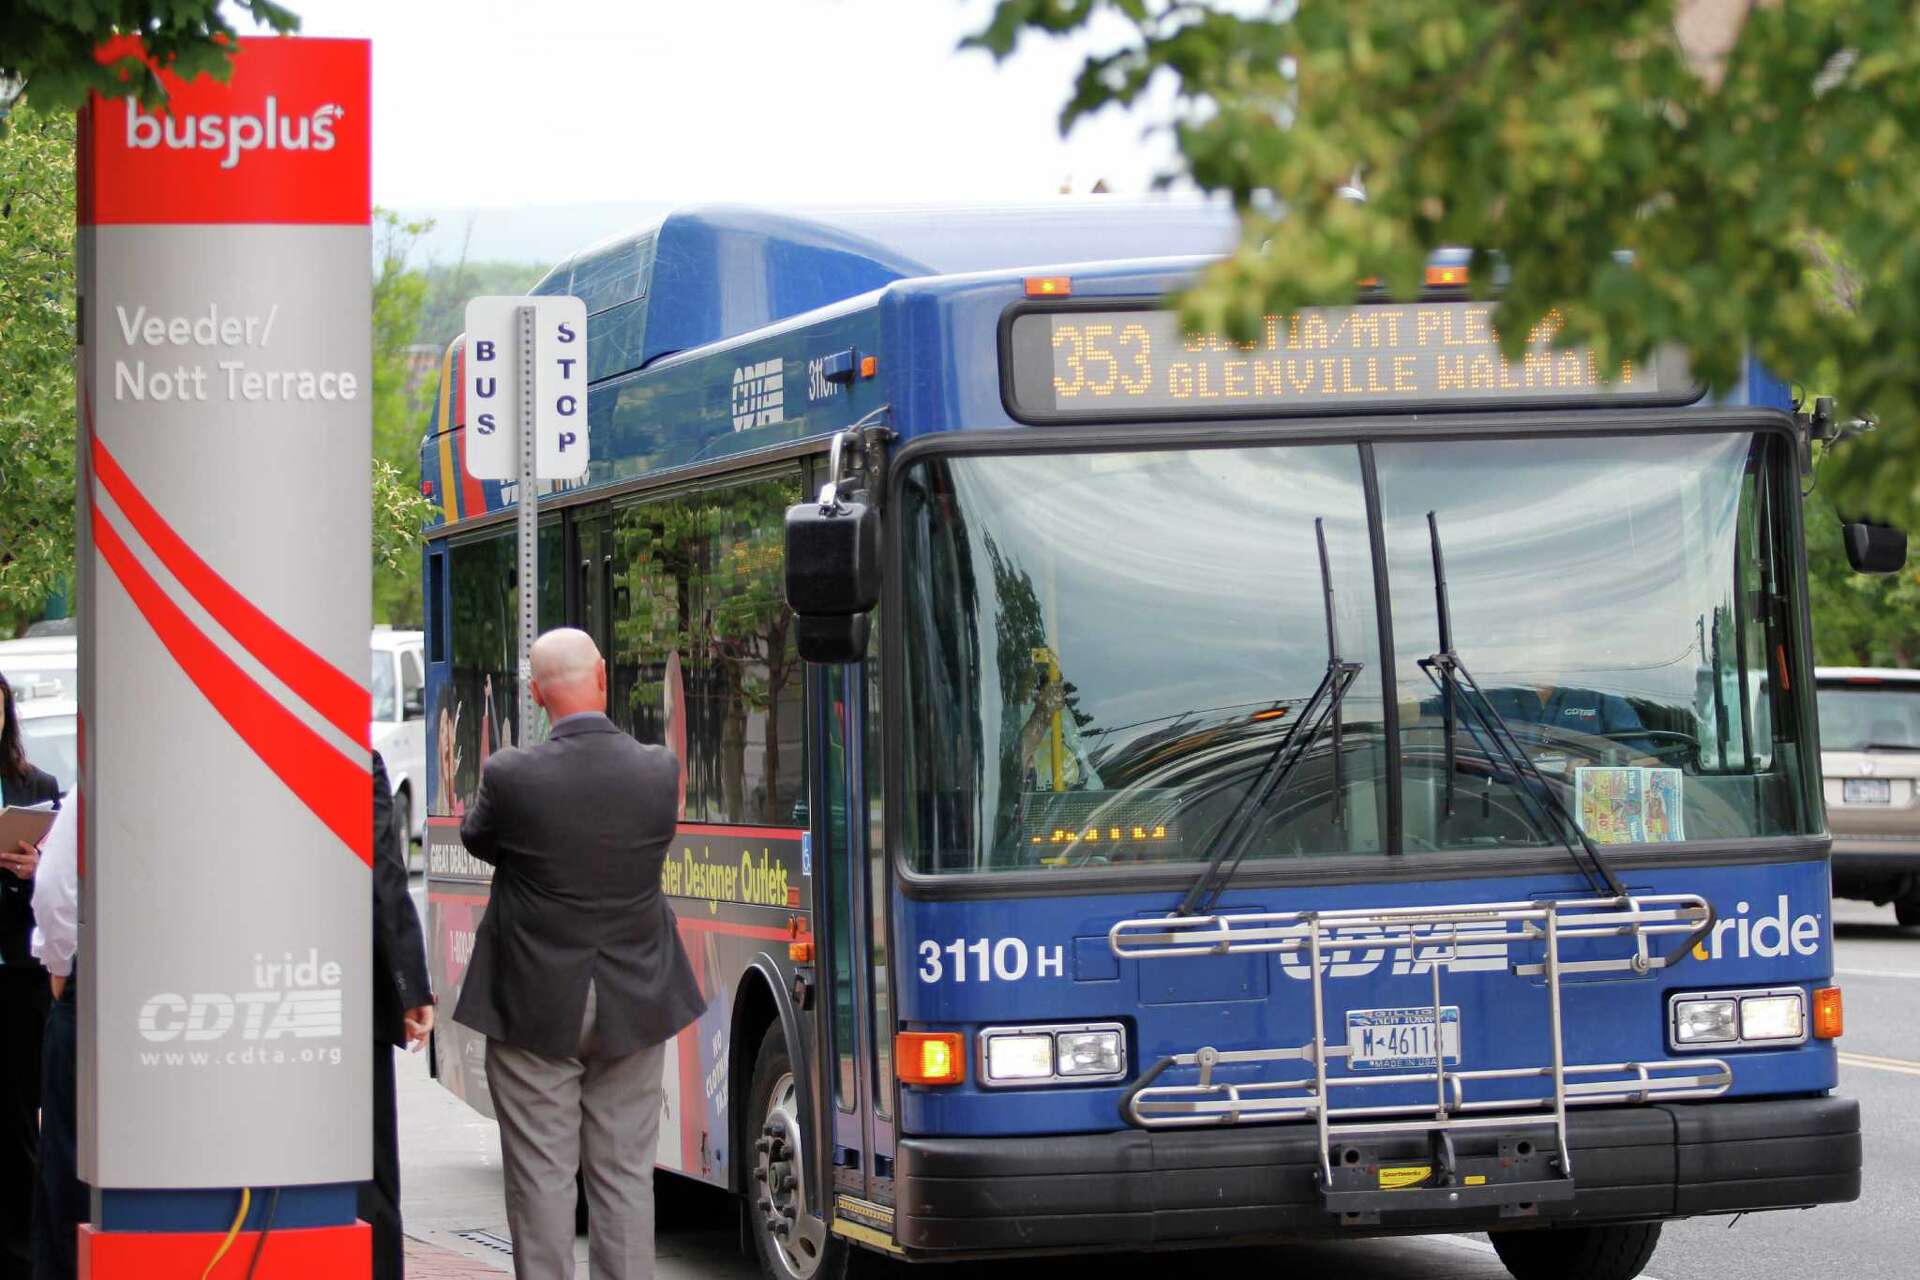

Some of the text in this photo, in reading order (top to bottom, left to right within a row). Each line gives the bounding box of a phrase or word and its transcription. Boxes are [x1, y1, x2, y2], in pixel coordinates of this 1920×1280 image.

[126, 96, 336, 169] busplus
[116, 303, 278, 348] Veeder/
[115, 360, 358, 402] Nott Terrace
[556, 321, 577, 453] STOP
[1052, 324, 1152, 398] 353
[1169, 355, 1417, 399] GLENVILLE
[475, 341, 497, 436] BUS
[732, 357, 784, 433] CDTA
[684, 845, 738, 915] Designer
[741, 847, 788, 906] Outlets
[253, 949, 343, 988] iride
[919, 937, 1063, 984] 3110 H
[1280, 920, 1509, 981] CDTA
[138, 989, 343, 1042] CDTA
[140, 1046, 343, 1066] www.cdta.org
[1374, 1058, 1402, 1069] MADE
